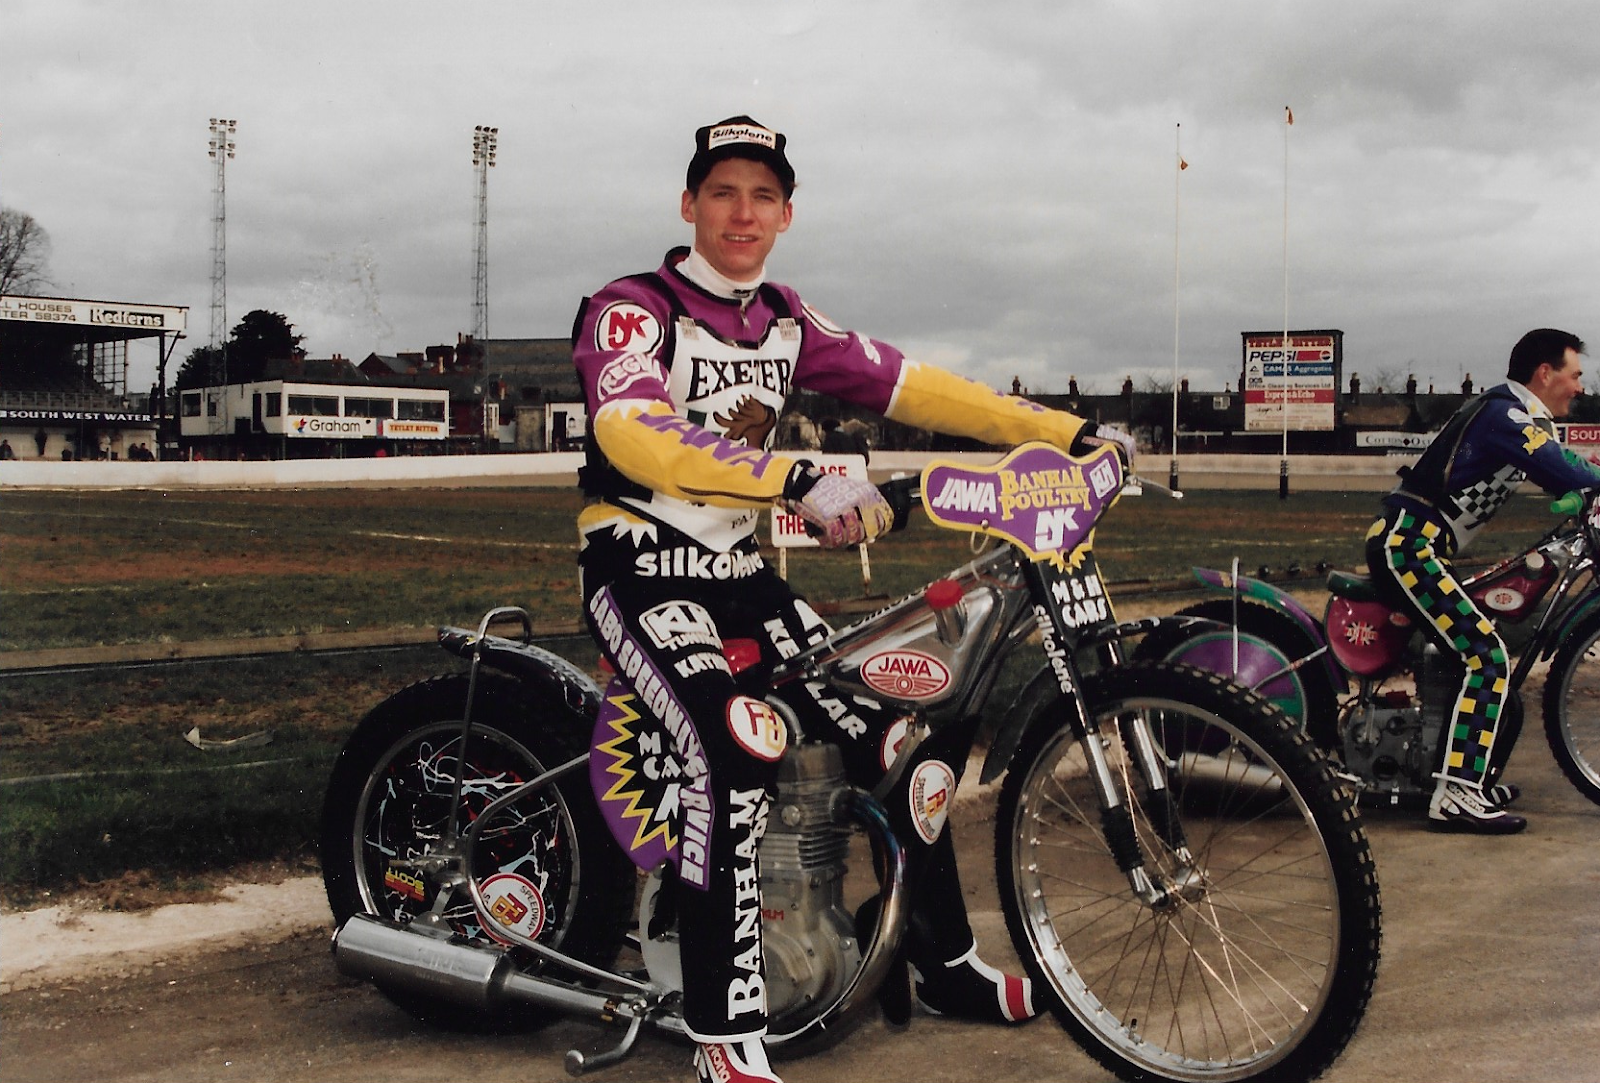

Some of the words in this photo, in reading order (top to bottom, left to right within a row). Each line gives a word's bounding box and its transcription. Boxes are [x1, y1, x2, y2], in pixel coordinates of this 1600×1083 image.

[712, 128, 773, 142] Silkolene
[18, 303, 72, 313] HOUSES
[35, 312, 76, 321] 58374
[1249, 350, 1297, 362] PEPSI
[1264, 365, 1292, 373] CAMS
[686, 356, 791, 401] EXETER
[9, 410, 58, 419] SOUTH
[62, 412, 100, 420] WEST
[104, 412, 151, 422] WATER
[309, 419, 361, 432] Graham
[998, 465, 1088, 495] BANHAM
[932, 478, 996, 514] JAWA
[998, 487, 1092, 521] POULTRY
[776, 515, 806, 535] THE
[1051, 579, 1071, 606] M
[1084, 574, 1102, 597] H
[1061, 597, 1107, 628] CARS
[762, 617, 867, 741] KELAR
[878, 656, 932, 677] JAWA
[618, 639, 700, 758] SPEEDWAY
[519, 885, 541, 932] SPEEDWAY
[726, 786, 770, 1022] BANHAM
